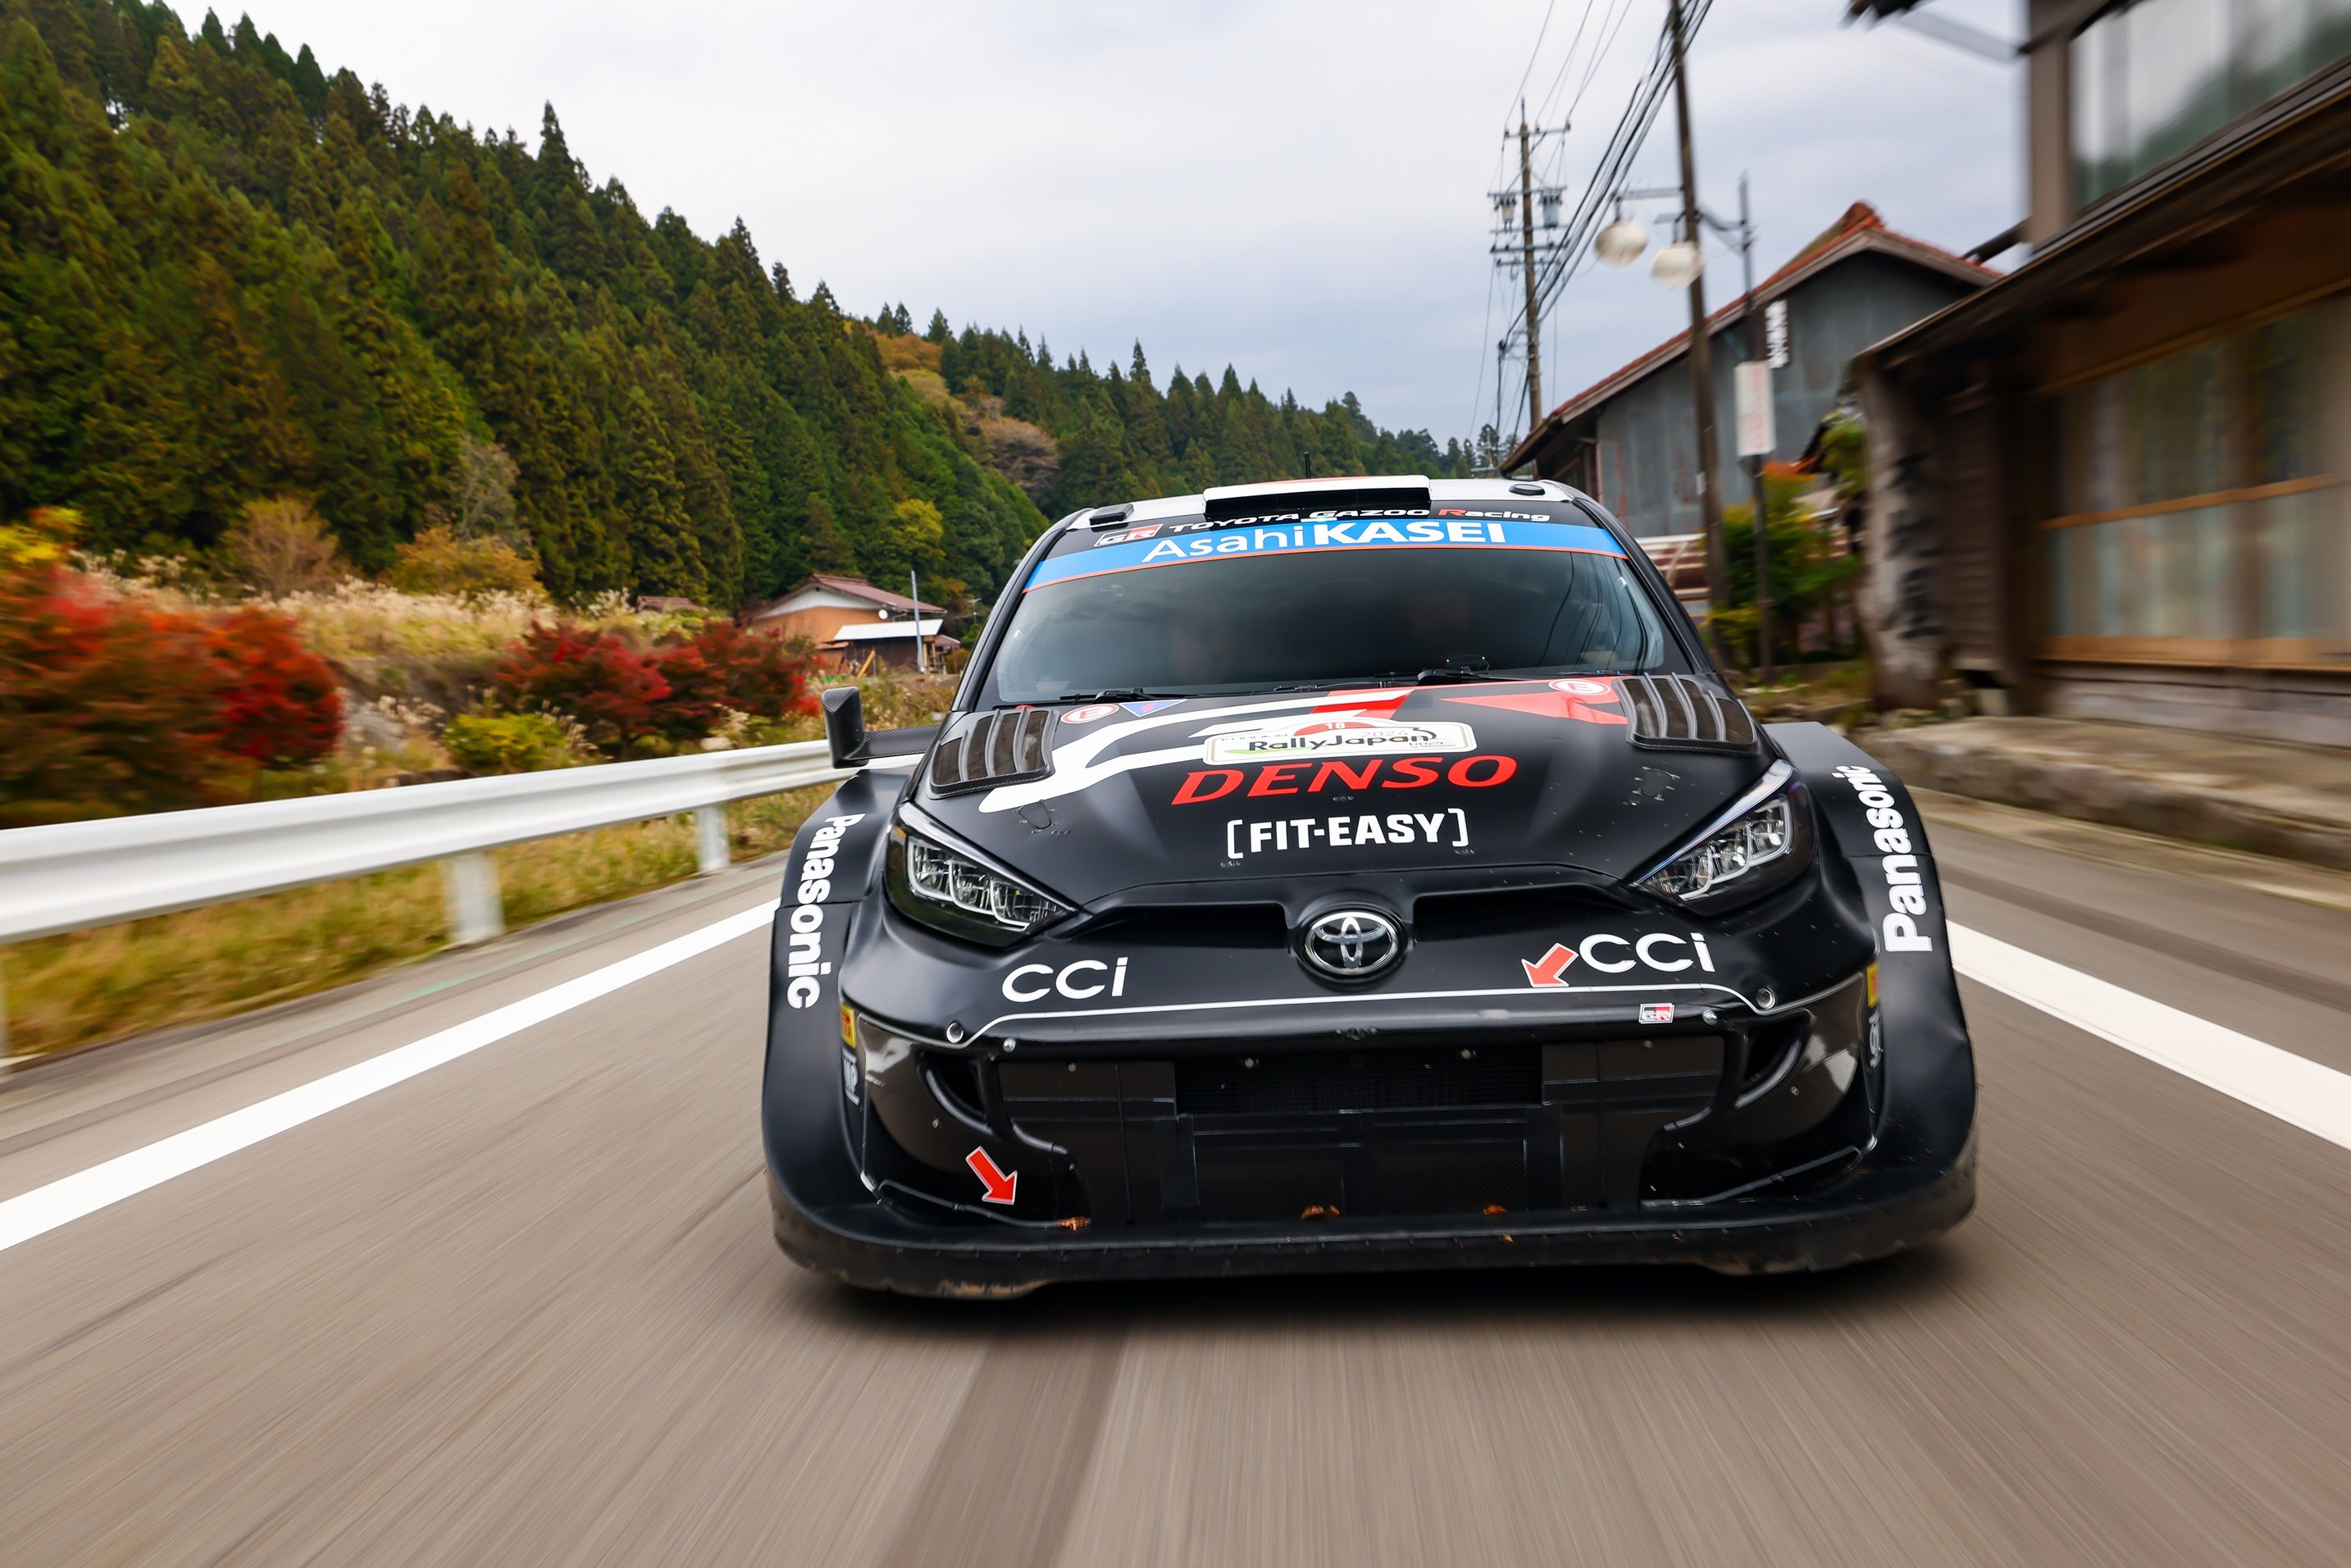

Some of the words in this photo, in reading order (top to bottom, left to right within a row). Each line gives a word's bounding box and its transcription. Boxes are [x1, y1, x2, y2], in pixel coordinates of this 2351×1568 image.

[1097, 526, 1159, 546] GR
[1169, 513, 1299, 533] TOYOTA
[1310, 508, 1431, 519] GAZOO
[1438, 508, 1551, 522] Racing
[1324, 722, 1345, 730] 18
[1360, 729, 1409, 738] 2024
[1171, 755, 1518, 806] DENSO
[1832, 764, 1933, 952] Panasonic
[786, 813, 866, 1010] Panasonic
